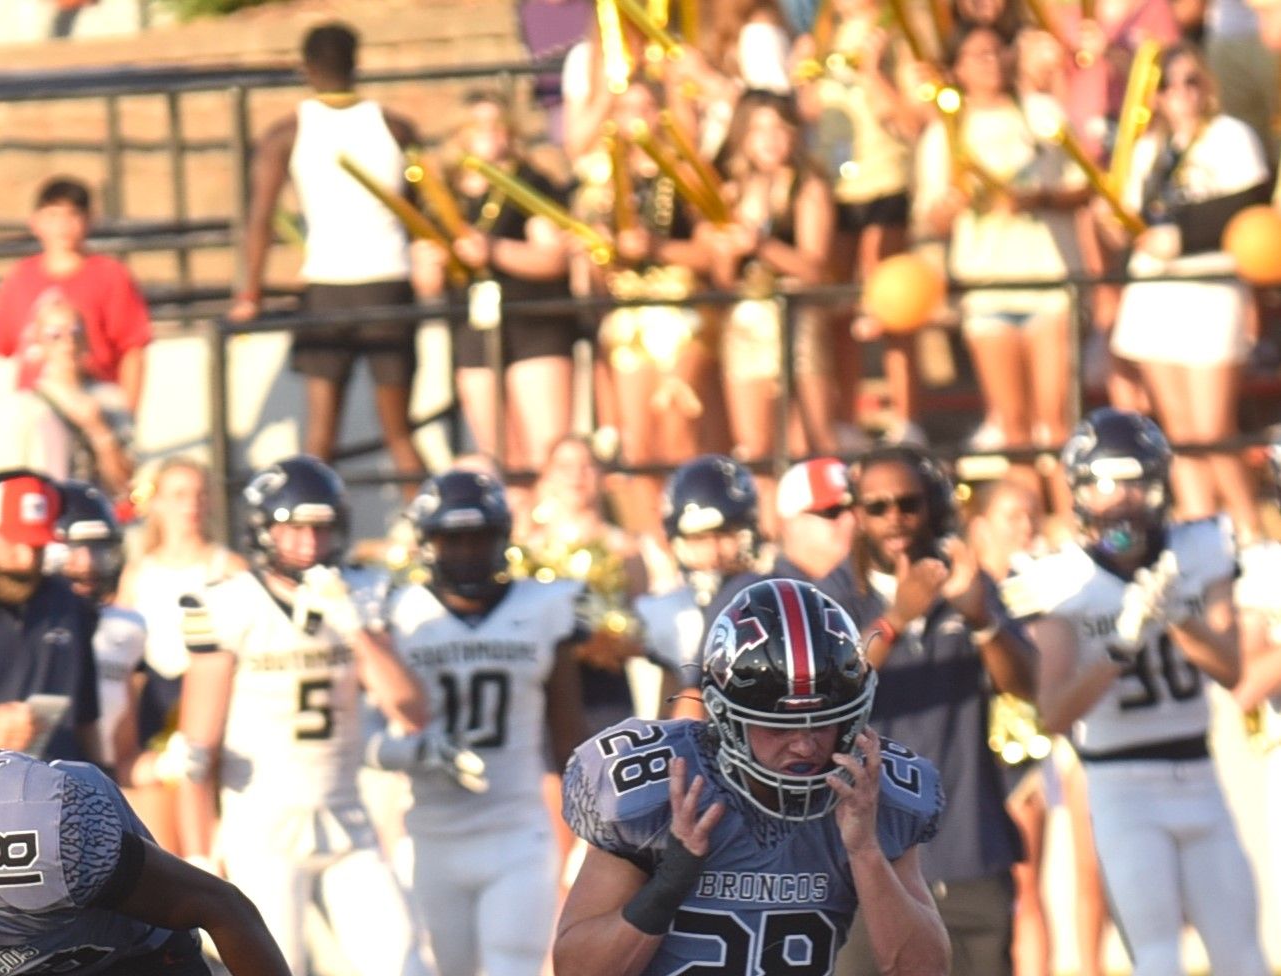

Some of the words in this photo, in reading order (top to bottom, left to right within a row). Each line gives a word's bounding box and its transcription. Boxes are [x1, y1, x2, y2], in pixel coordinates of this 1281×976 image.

[295, 679, 335, 741] 5
[439, 669, 511, 748] 10
[597, 725, 677, 796] 28
[696, 870, 829, 904] BRONCOS
